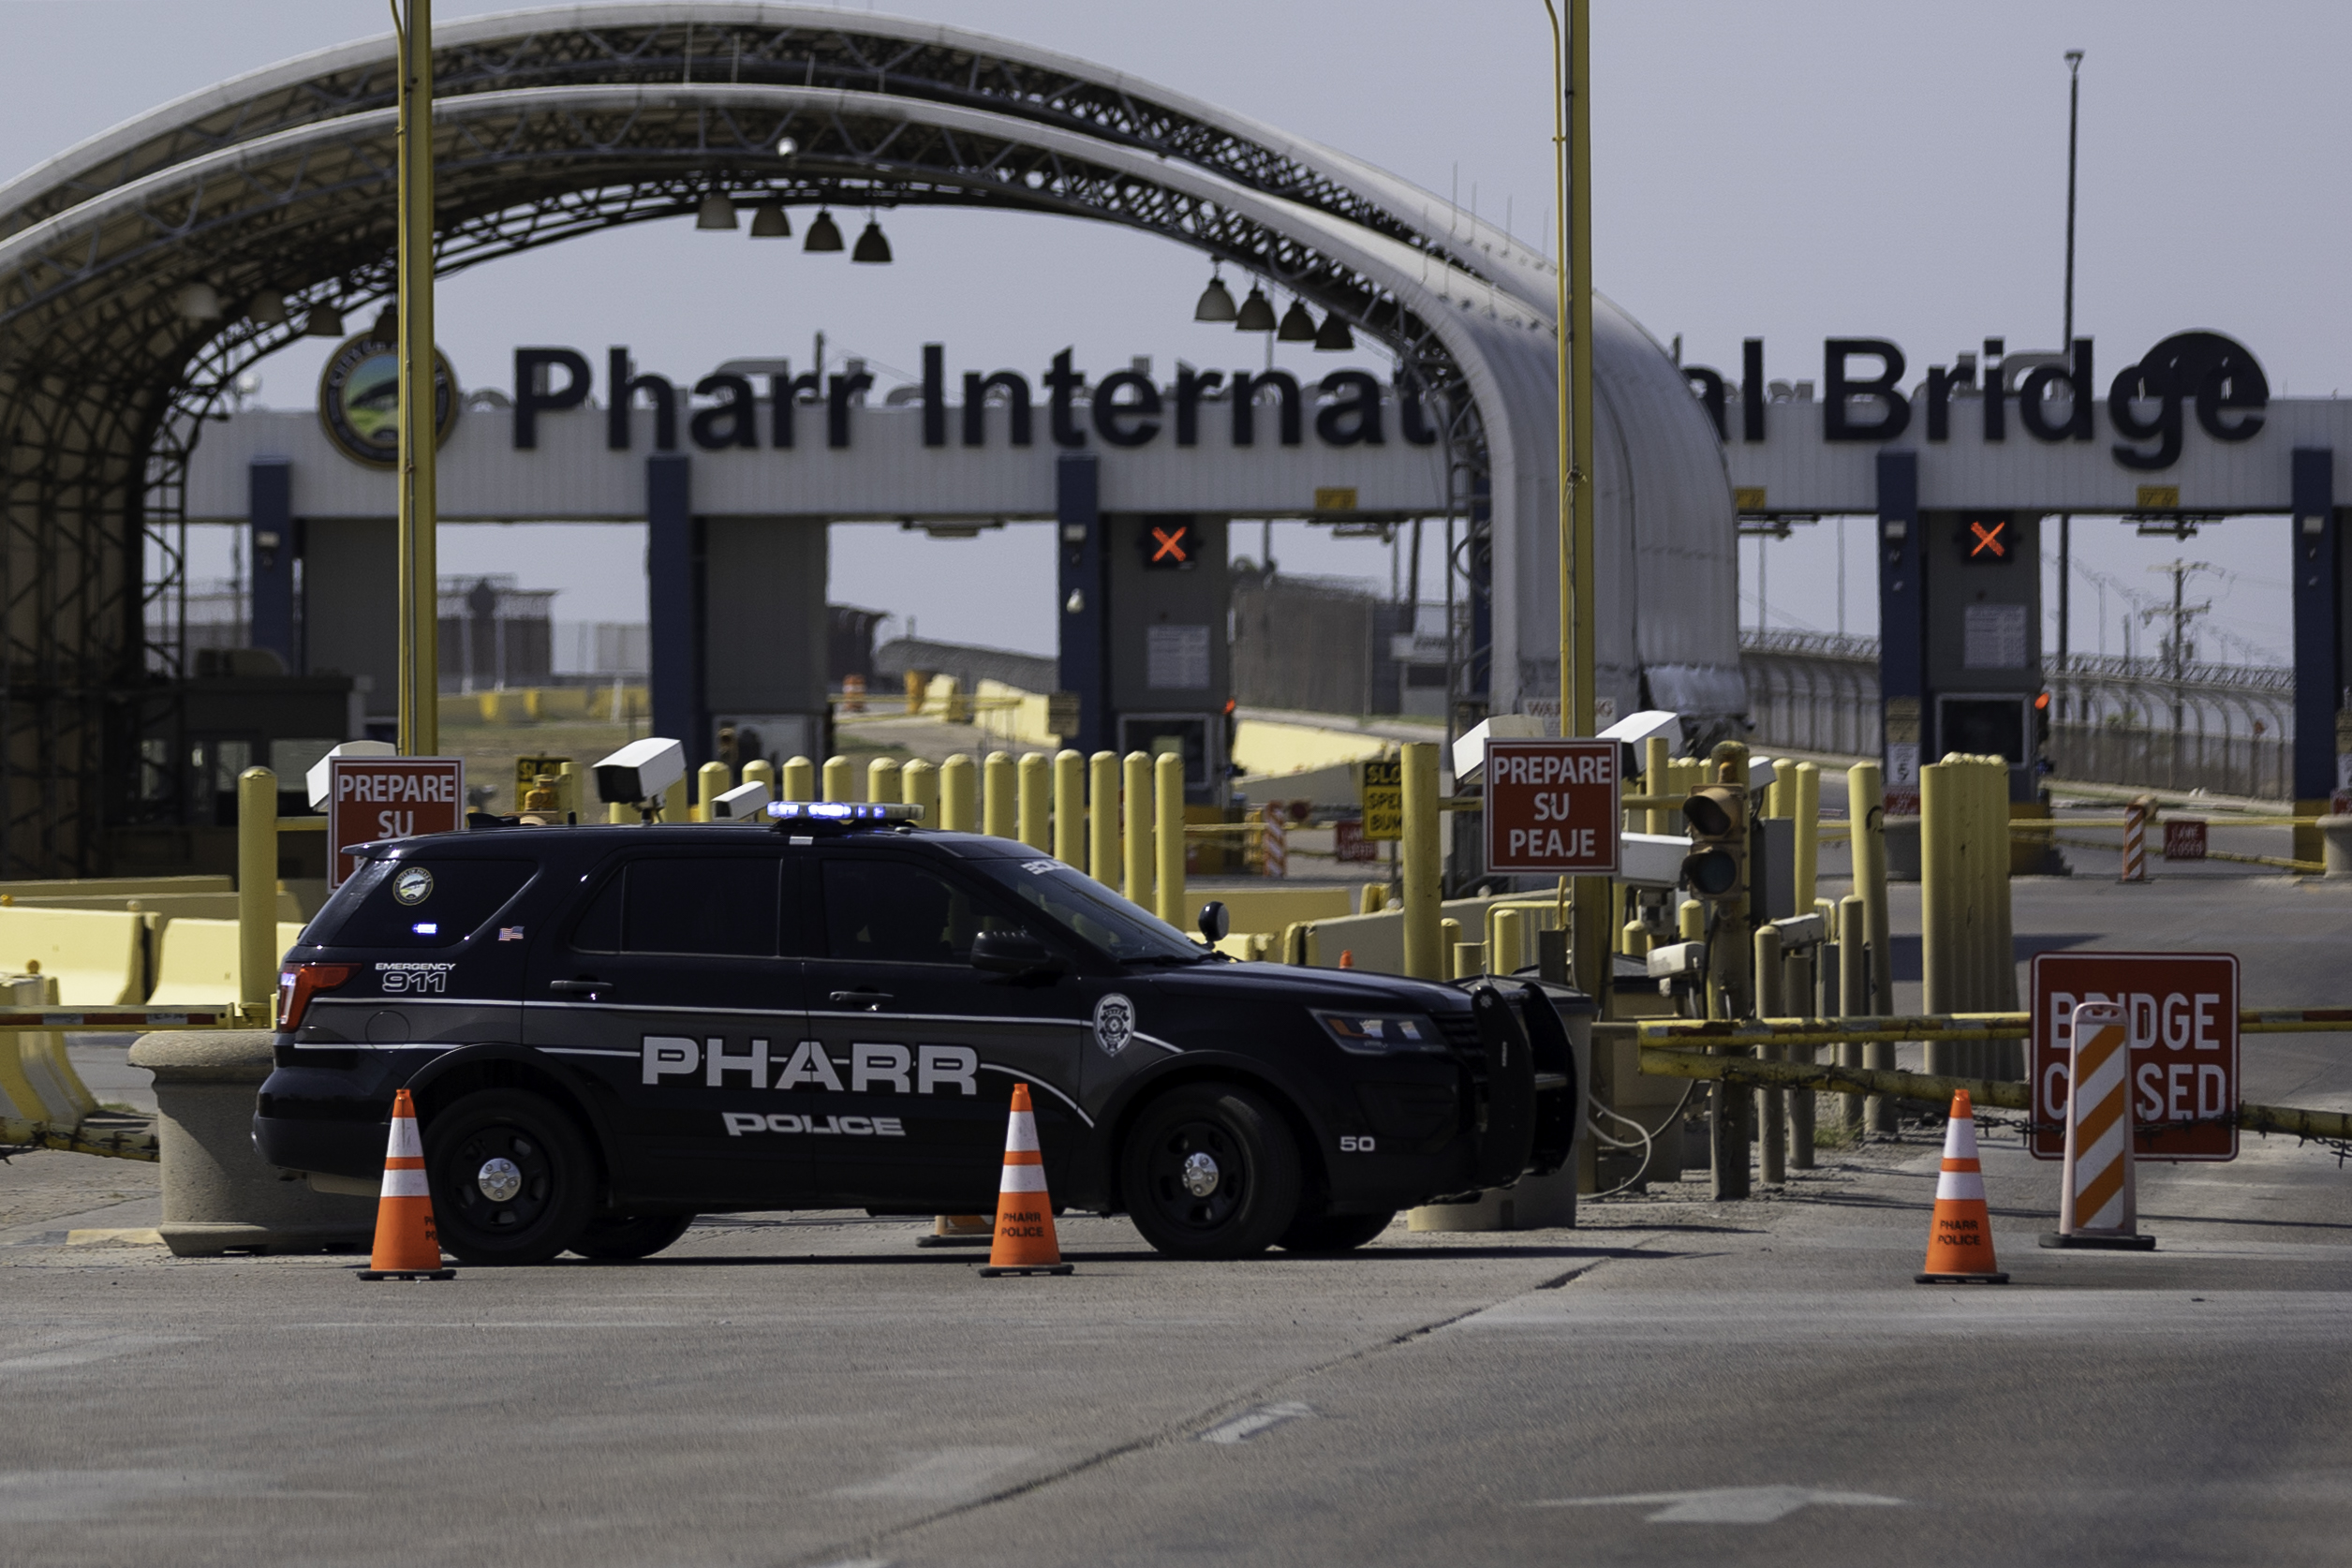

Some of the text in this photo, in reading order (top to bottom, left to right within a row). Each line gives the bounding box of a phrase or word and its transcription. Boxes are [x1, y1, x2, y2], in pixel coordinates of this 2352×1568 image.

[513, 346, 875, 450] Pharr
[1824, 336, 2267, 470] Bridge
[1368, 765, 1401, 784] SLO
[1494, 756, 1611, 784] PREPARE
[338, 775, 455, 803] PREPARE
[1533, 792, 1570, 821] SU
[377, 810, 415, 838] SU
[1509, 829, 1596, 858] PEAJE
[381, 971, 447, 993] 911
[2049, 991, 2221, 1051] BDGE
[643, 1035, 978, 1095] PHARR
[2043, 1061, 2226, 1122] CSED
[721, 1112, 907, 1136] POLICE
[1339, 1135, 1376, 1152] 50
[1002, 1212, 1042, 1223] PHARR
[1940, 1220, 1978, 1231] PHARR
[1001, 1226, 1044, 1238] POLICE
[1938, 1234, 1981, 1246] POLICE
